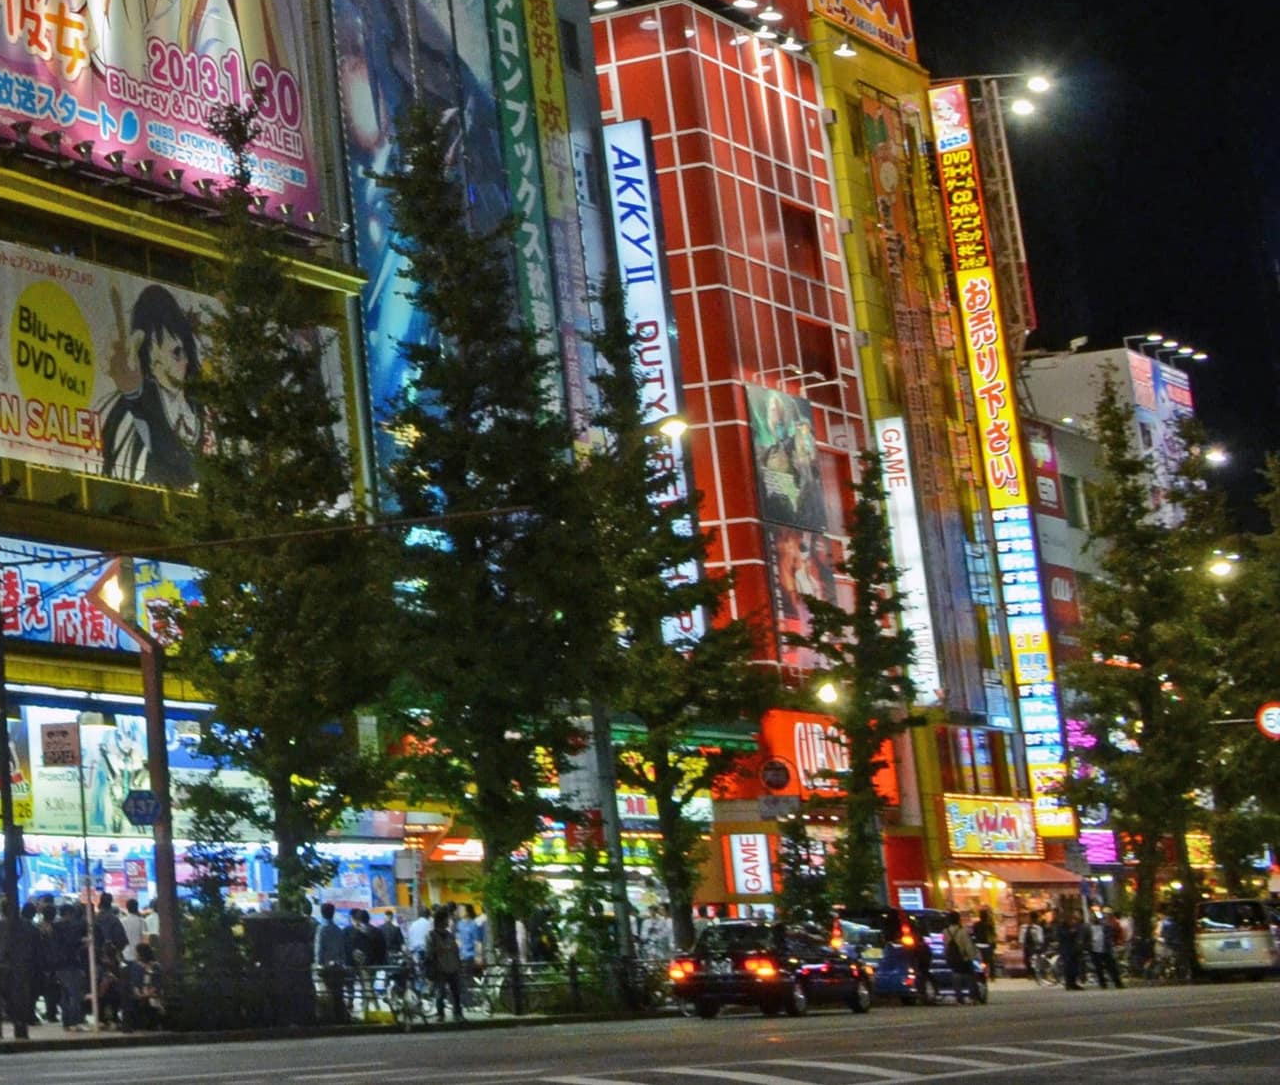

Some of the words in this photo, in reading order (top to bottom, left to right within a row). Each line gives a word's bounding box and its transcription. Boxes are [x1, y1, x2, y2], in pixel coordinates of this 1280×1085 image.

[106, 64, 170, 117] Blu-ray
[148, 37, 302, 131] 2013.1.30
[184, 132, 218, 155] TOKYO
[943, 151, 970, 165] DVD
[611, 144, 654, 256] AKKY
[947, 178, 976, 191] ゲーム
[952, 190, 973, 204] CD
[952, 216, 982, 230] アニメ
[17, 341, 57, 381] DVD
[634, 320, 669, 415] DUTY
[881, 428, 908, 488] GAME
[740, 834, 763, 893] GAME
